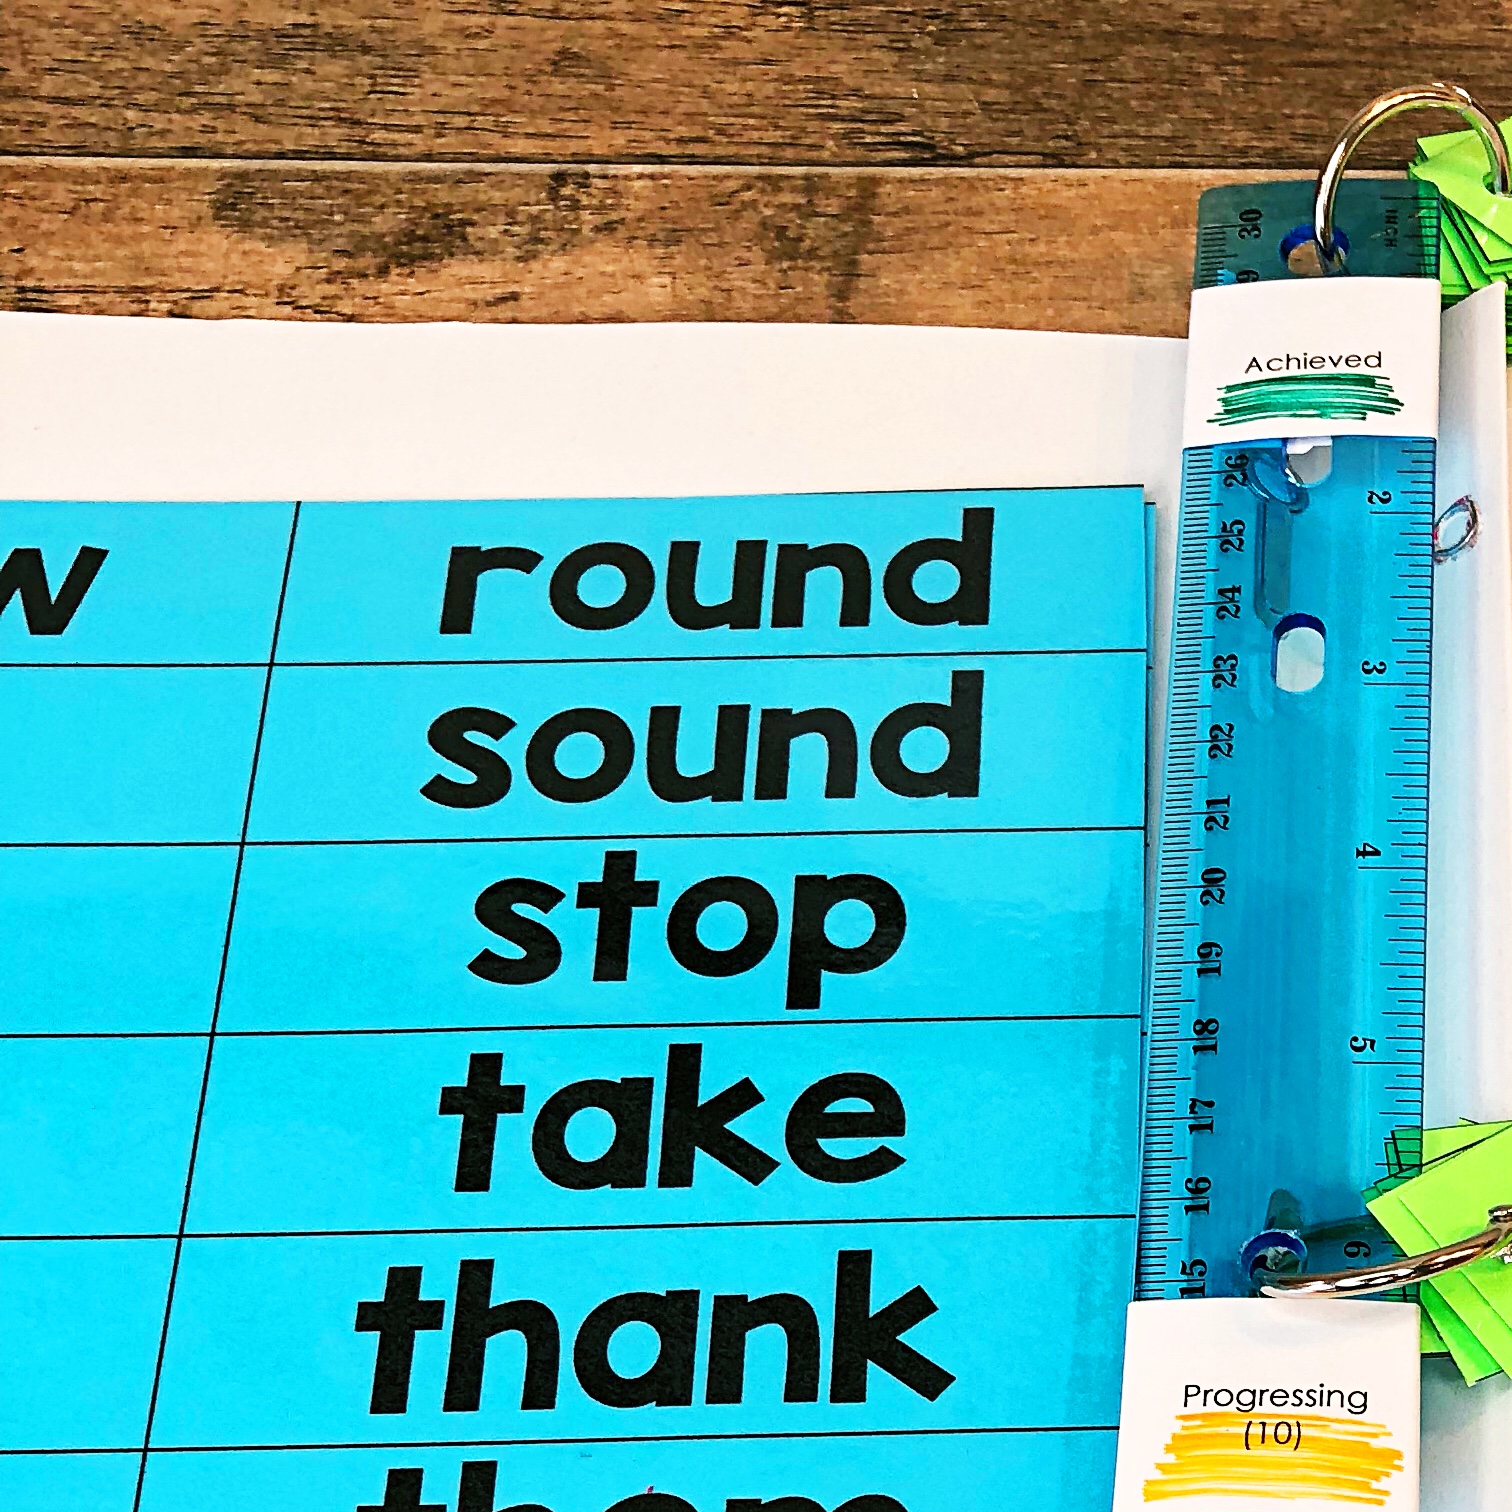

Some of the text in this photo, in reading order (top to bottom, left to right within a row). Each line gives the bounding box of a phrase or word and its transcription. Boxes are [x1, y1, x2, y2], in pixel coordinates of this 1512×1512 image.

[1238, 208, 1263, 240] 30
[1245, 351, 1384, 374] Achieved
[1367, 490, 1393, 505] 2
[1219, 518, 1246, 554] 25
[440, 508, 994, 634] round
[1216, 584, 1243, 621] 24
[1212, 653, 1239, 690] 23
[1361, 659, 1388, 675] 3
[420, 669, 985, 808] sound
[1208, 721, 1236, 760] 22
[1204, 794, 1233, 833] 21
[1355, 841, 1383, 859] 4
[1200, 866, 1228, 906] 20
[468, 850, 906, 1009] stop
[1197, 941, 1225, 978] 19
[1193, 1018, 1220, 1056] 18
[1349, 1035, 1377, 1055] 5
[439, 1043, 906, 1192] take
[1188, 1097, 1216, 1135] 17
[1184, 1175, 1213, 1215] 16
[355, 1250, 956, 1414] thank
[1184, 1385, 1367, 1414] Progressing
[1245, 1421, 1301, 1450] (10)
